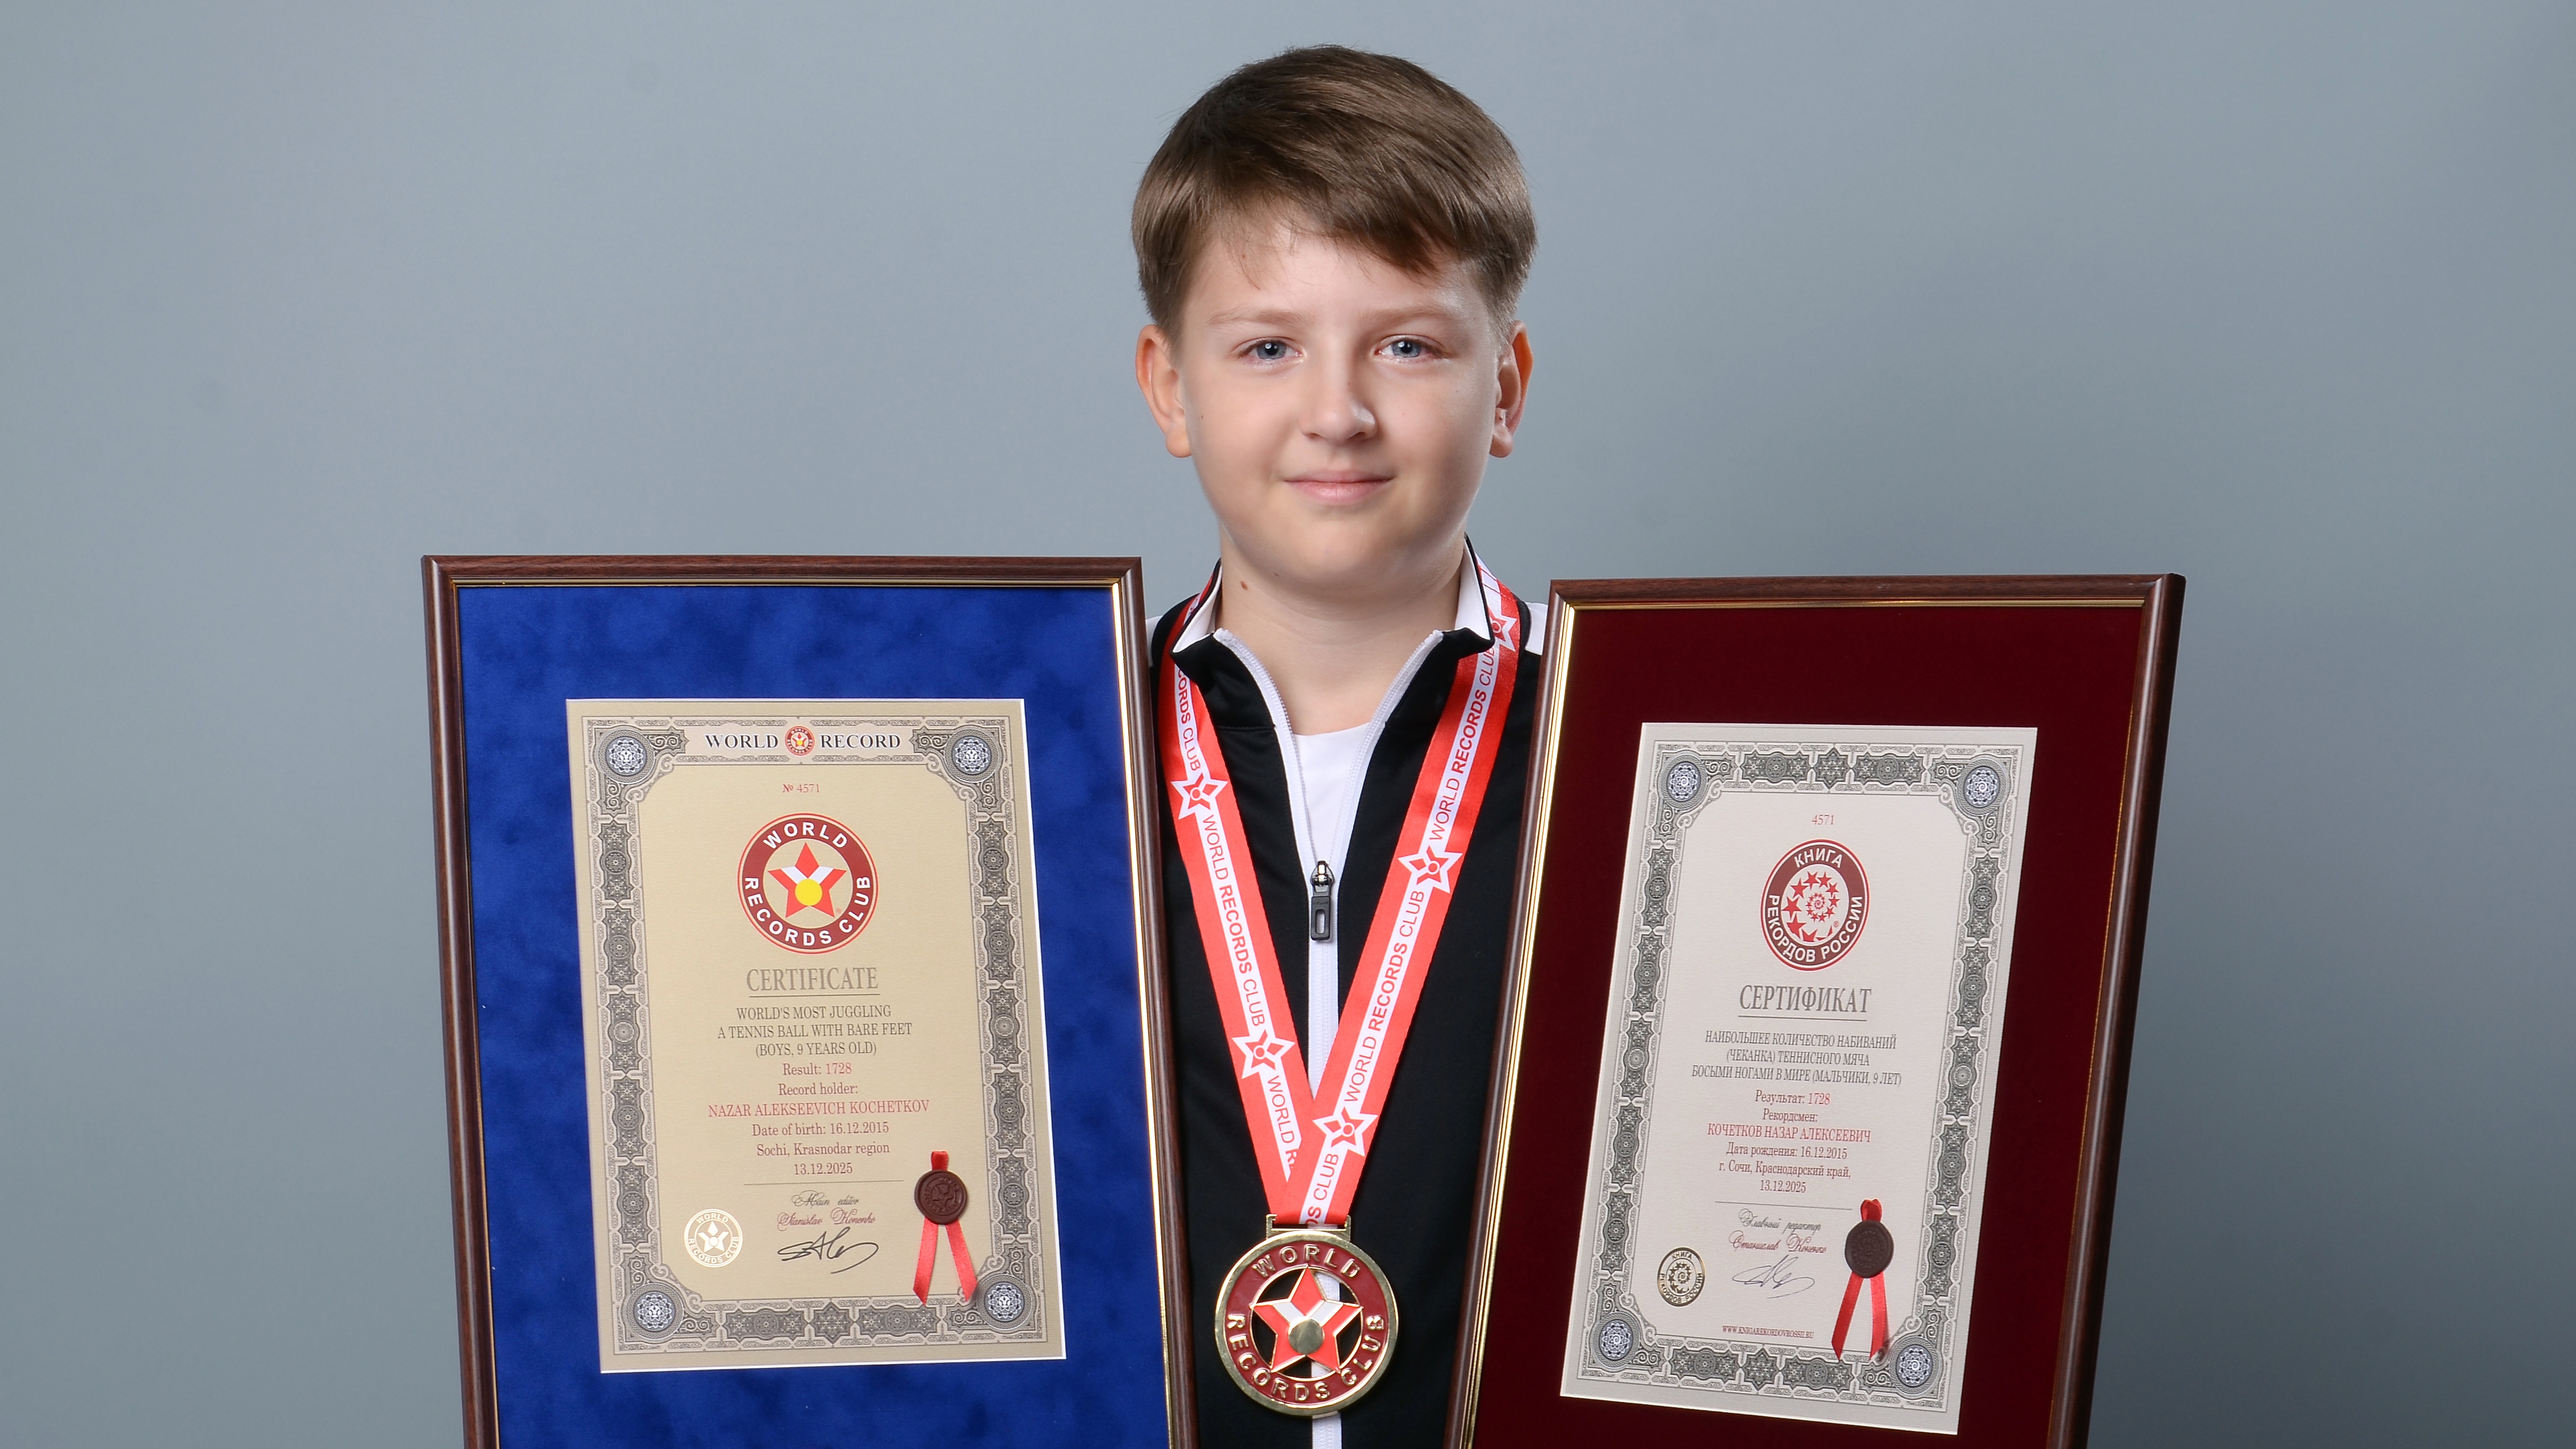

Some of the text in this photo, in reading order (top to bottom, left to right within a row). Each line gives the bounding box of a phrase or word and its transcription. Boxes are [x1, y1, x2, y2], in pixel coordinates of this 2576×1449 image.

[705, 733, 901, 750] WORLD RECORD
[1183, 728, 1201, 771] CLUB
[1429, 778, 1459, 840] WORLD
[1453, 690, 1487, 774] RECORDS
[782, 783, 820, 794] № 4571
[1812, 815, 1835, 825] 4571
[763, 821, 848, 852] WORLD
[1794, 849, 1843, 868] КНИГА
[745, 876, 871, 946] RECORDS CLUB
[1203, 815, 1265, 1026] WORLD RECORDS CLUB
[1769, 894, 1863, 962] РЕКОРДОВ РОССИИ
[747, 968, 878, 991] CERTIFICATE
[1344, 890, 1423, 1102] WORLD RECORDS CLUB
[1740, 985, 1872, 1013] СЕРТИФИКАТ
[737, 1005, 891, 1020] WORLD'S MOST JUGGLING
[717, 1022, 912, 1039] A TENNIS BALL WITH BARE FEET
[756, 1041, 877, 1057] (BOYS, 9 YEARS OLD)
[1706, 1031, 1897, 1049] НАИБОЛЬШЕЕ КОЛИЧЕСТВО НАБИВАНИЙ
[1727, 1049, 1869, 1066] (ЧЕКАНКА) ТЕННИСНОГО МЯЧА
[783, 1063, 852, 1075] Result: 1728
[1692, 1065, 1901, 1087] БОСЫМИ НОГАМИ В МИРЕ (МАЛЬЧИКИ, 9 ЛЕТ)
[778, 1083, 858, 1096] Record holder:
[1755, 1089, 1830, 1105] Результат: 1728
[708, 1100, 930, 1117] NAZAR ALEKSEEVICH KOCHETKOV
[1268, 1075, 1295, 1143] WORLD
[1763, 1108, 1818, 1124] Рекордсмен:
[752, 1121, 889, 1136] Date of birth: 16.12.2015
[1708, 1124, 1871, 1142] КОЧЕТКОВ НАЗАР АЛЕКСЕЕВИЧ
[757, 1142, 890, 1158] Sochi, Krasnodar region
[1726, 1142, 1847, 1159] Дата рождения: 16.12.2015
[794, 1162, 853, 1175] 13.12.2025
[1314, 1154, 1339, 1200] CLUB
[1728, 1161, 1753, 1173] Сочи,
[1756, 1162, 1824, 1177] Краснодарский
[1827, 1164, 1851, 1178] край,
[1760, 1180, 1806, 1193] 13.12.2025
[792, 1190, 859, 1208] Main editor
[696, 1213, 728, 1224] WORLD
[777, 1207, 876, 1231] Stanislav Konenko
[1739, 1208, 1821, 1236] Главный редактор
[1729, 1230, 1781, 1252] Станислав
[688, 1237, 738, 1264] RECORDS CLUB
[1253, 1245, 1360, 1278] WORLD
[1660, 1273, 1682, 1303] РЕКОРДОВ
[1685, 1273, 1702, 1301] РОССИИ
[1227, 1314, 1384, 1401] RECORDS CLUB
